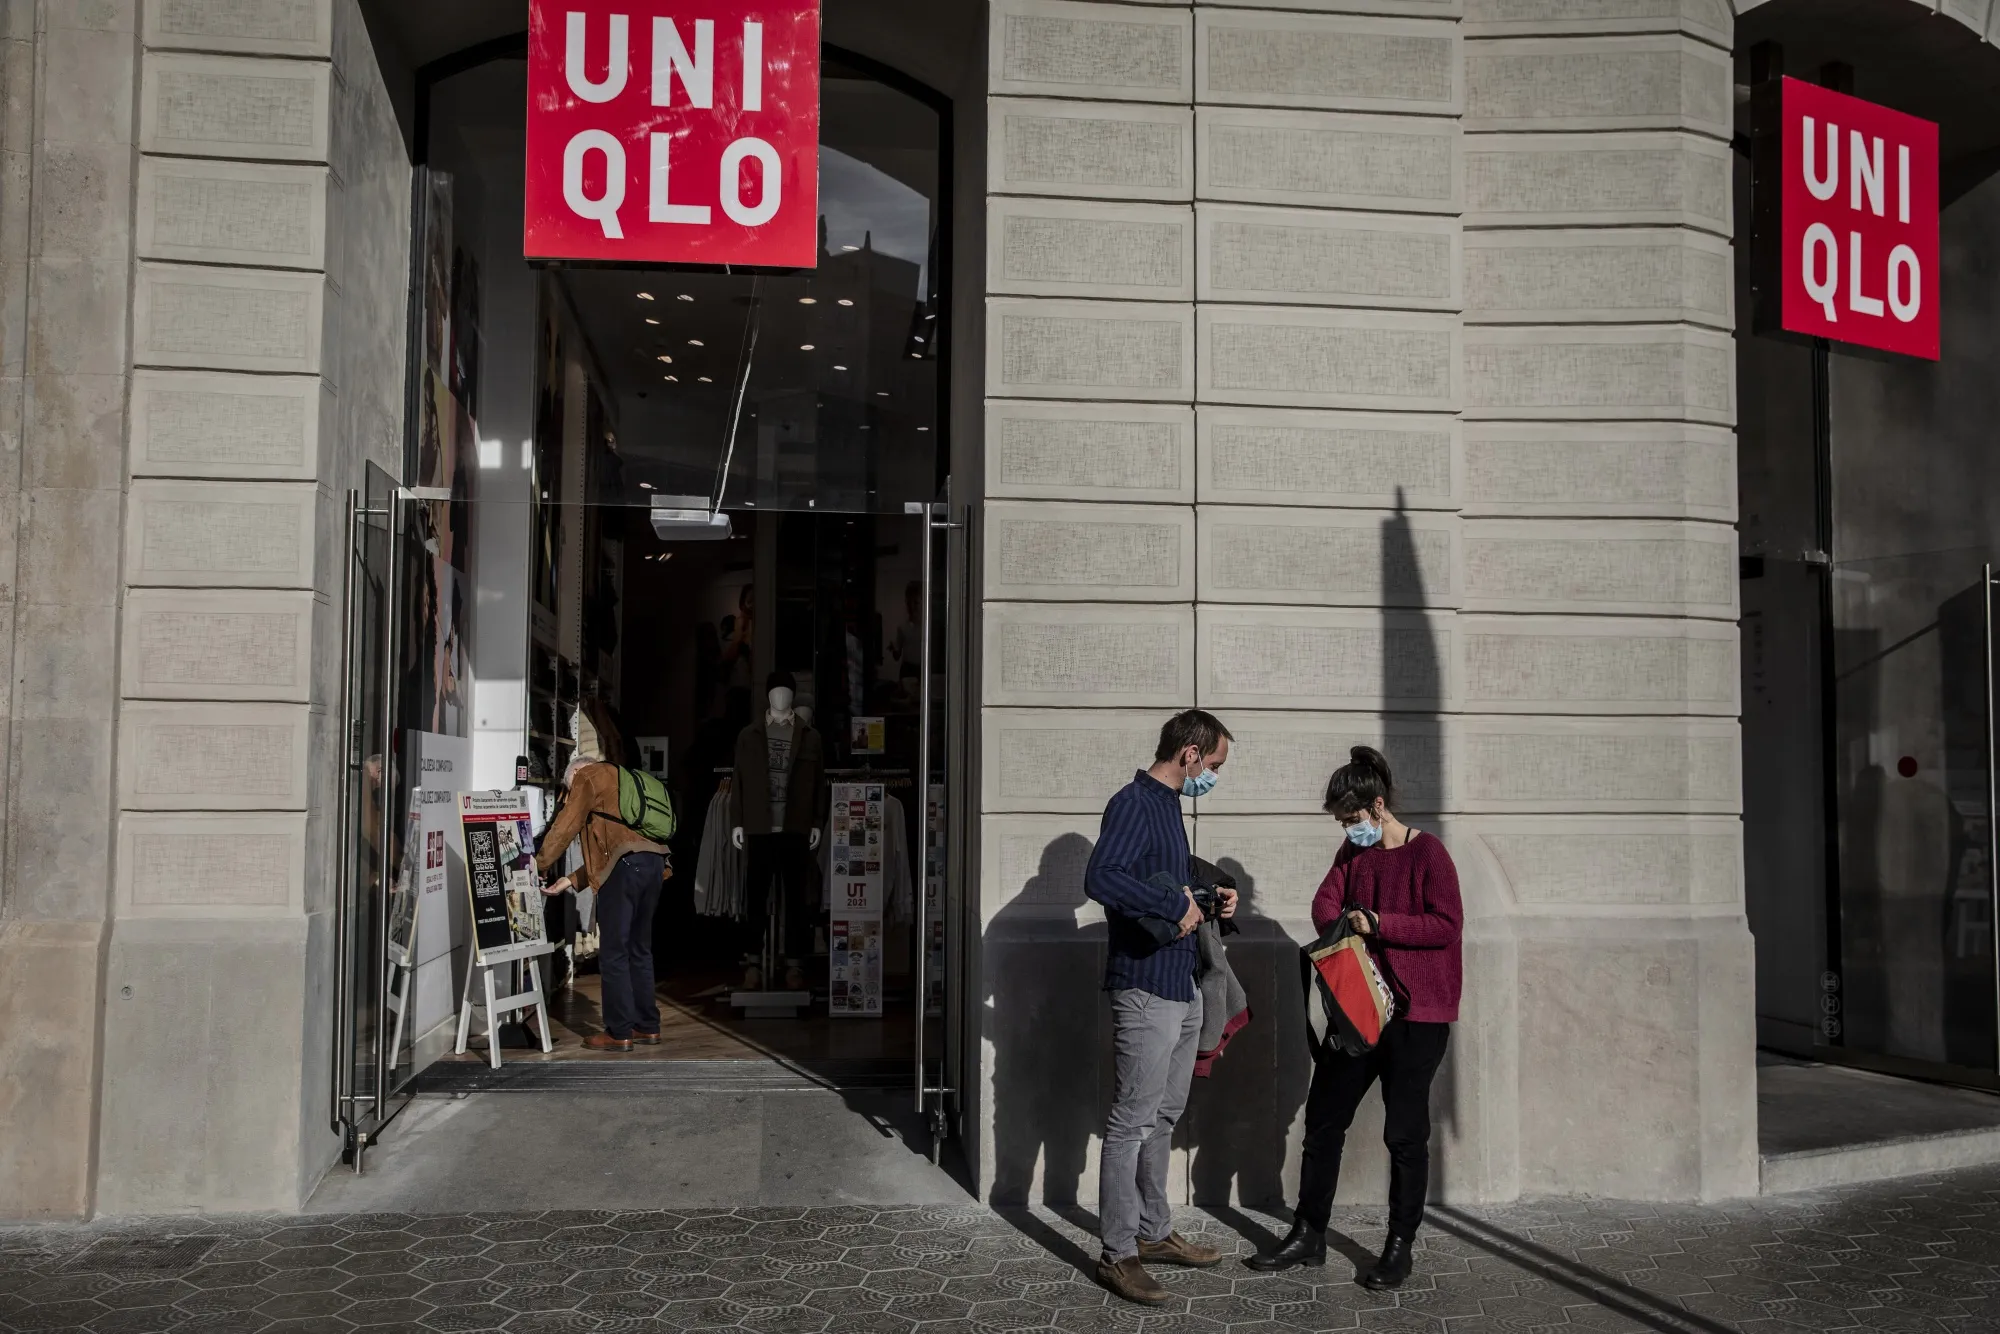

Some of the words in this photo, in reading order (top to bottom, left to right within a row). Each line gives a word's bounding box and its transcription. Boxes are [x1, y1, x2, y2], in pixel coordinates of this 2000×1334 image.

[565, 11, 762, 112] UNI
[562, 129, 782, 239] QLO
[1802, 115, 1910, 224] UNI
[1802, 222, 1921, 323] QLO
[462, 795, 471, 809] UT
[847, 883, 867, 898] UT
[847, 899, 867, 907] 2021
